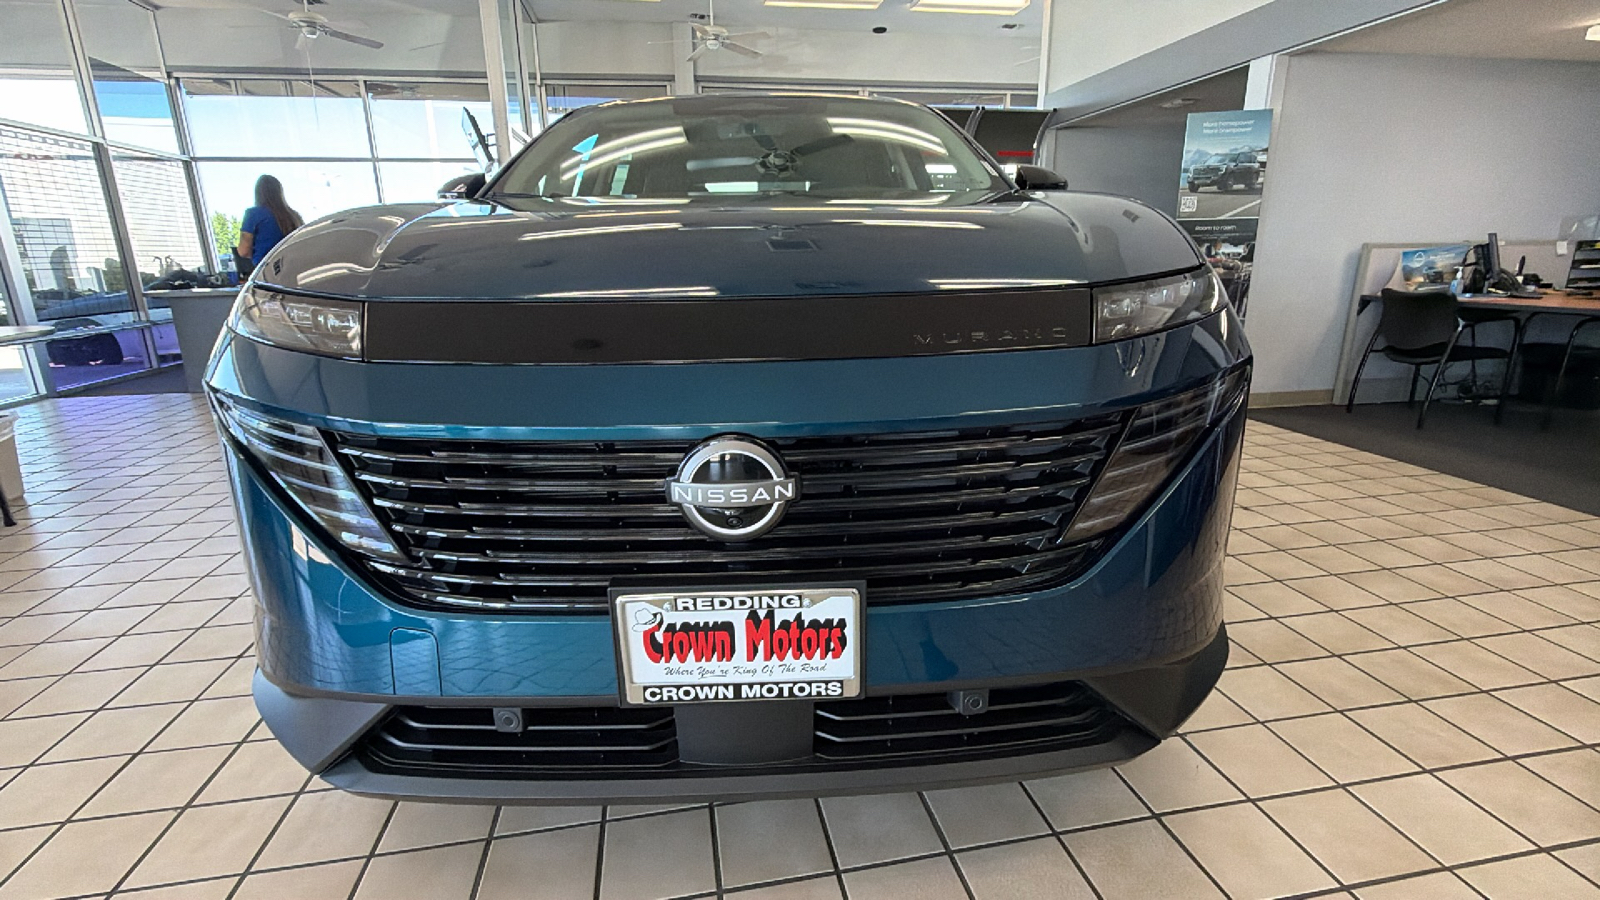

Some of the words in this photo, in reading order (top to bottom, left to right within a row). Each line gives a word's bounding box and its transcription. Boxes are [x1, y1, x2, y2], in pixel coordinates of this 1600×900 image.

[913, 327, 1067, 344] MURANO
[674, 483, 793, 502] NISSAN
[676, 594, 801, 611] REDDING
[643, 612, 736, 664] Crown
[745, 610, 847, 662] Motors
[663, 666, 694, 676] Where
[697, 665, 729, 679] You're
[733, 665, 757, 677] King
[761, 664, 775, 676] Of
[778, 663, 796, 674] The
[799, 663, 828, 673] Road
[644, 684, 734, 702] CROWN
[741, 681, 843, 699] MOTORS
